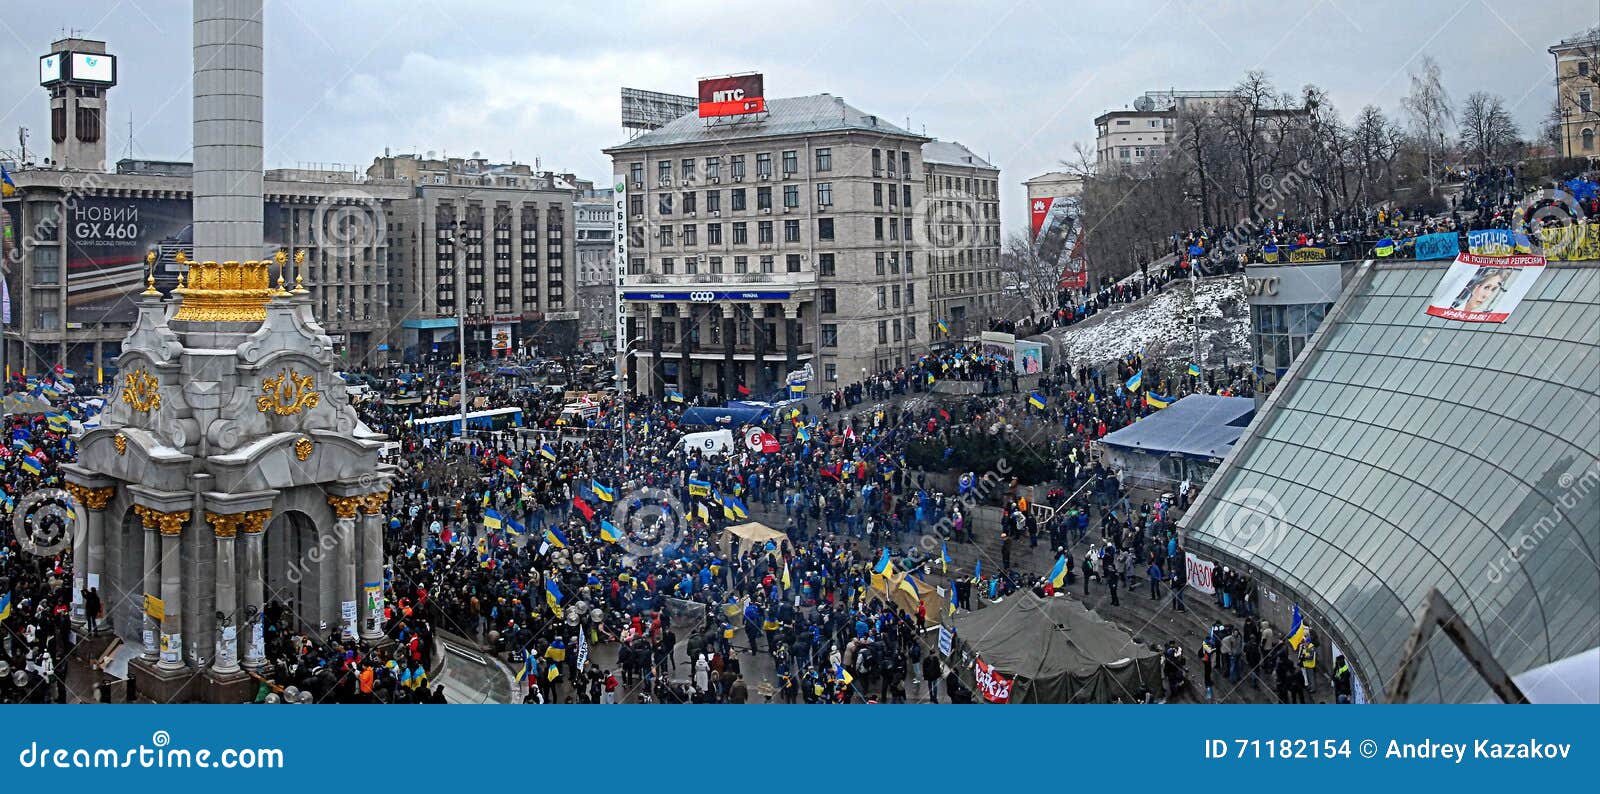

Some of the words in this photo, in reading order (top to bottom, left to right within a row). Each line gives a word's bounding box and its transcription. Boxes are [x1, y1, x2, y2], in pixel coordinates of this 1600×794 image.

[713, 88, 745, 103] МТС
[75, 204, 138, 221] НОВИЙ
[75, 222, 101, 239] GX
[104, 223, 138, 239] 460
[617, 201, 625, 286] СБЕРБАНК
